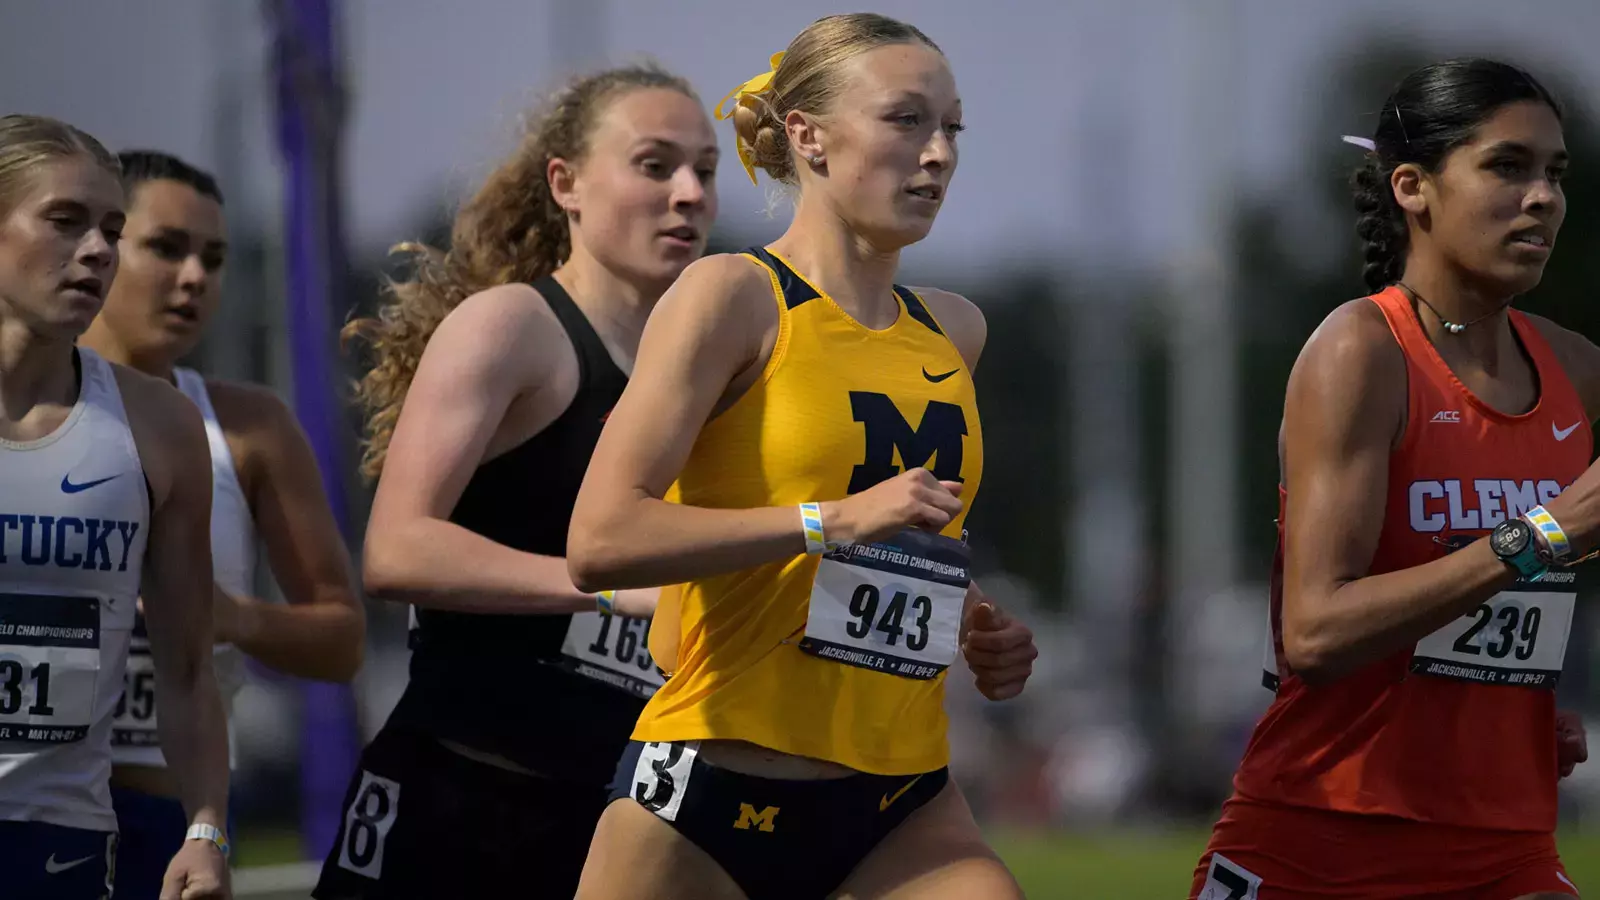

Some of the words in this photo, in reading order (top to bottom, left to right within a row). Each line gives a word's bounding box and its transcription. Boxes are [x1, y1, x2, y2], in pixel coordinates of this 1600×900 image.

[1431, 411, 1460, 421] ACC
[847, 391, 968, 495] M
[853, 544, 882, 559] TRACK
[881, 550, 888, 560] &
[887, 551, 909, 566] FIELD
[909, 556, 965, 577] CHAMPIONSHIPS
[16, 624, 94, 640] CHAMPIONSHIPS
[846, 583, 933, 651] 943
[1452, 604, 1542, 661] 239
[818, 646, 875, 667] JACKSONVILLE,
[875, 657, 886, 668] FL
[898, 662, 917, 674] MAY
[915, 666, 937, 677] 24-27
[1426, 662, 1487, 681] JACKSONVILLE,
[1487, 671, 1497, 682] FL
[1507, 673, 1524, 683] MAY
[1523, 674, 1545, 684] 24-27
[0, 660, 54, 716] 31
[28, 728, 50, 740] MAY
[635, 742, 685, 812] 3
[347, 781, 389, 868] 8
[733, 802, 780, 832] M
